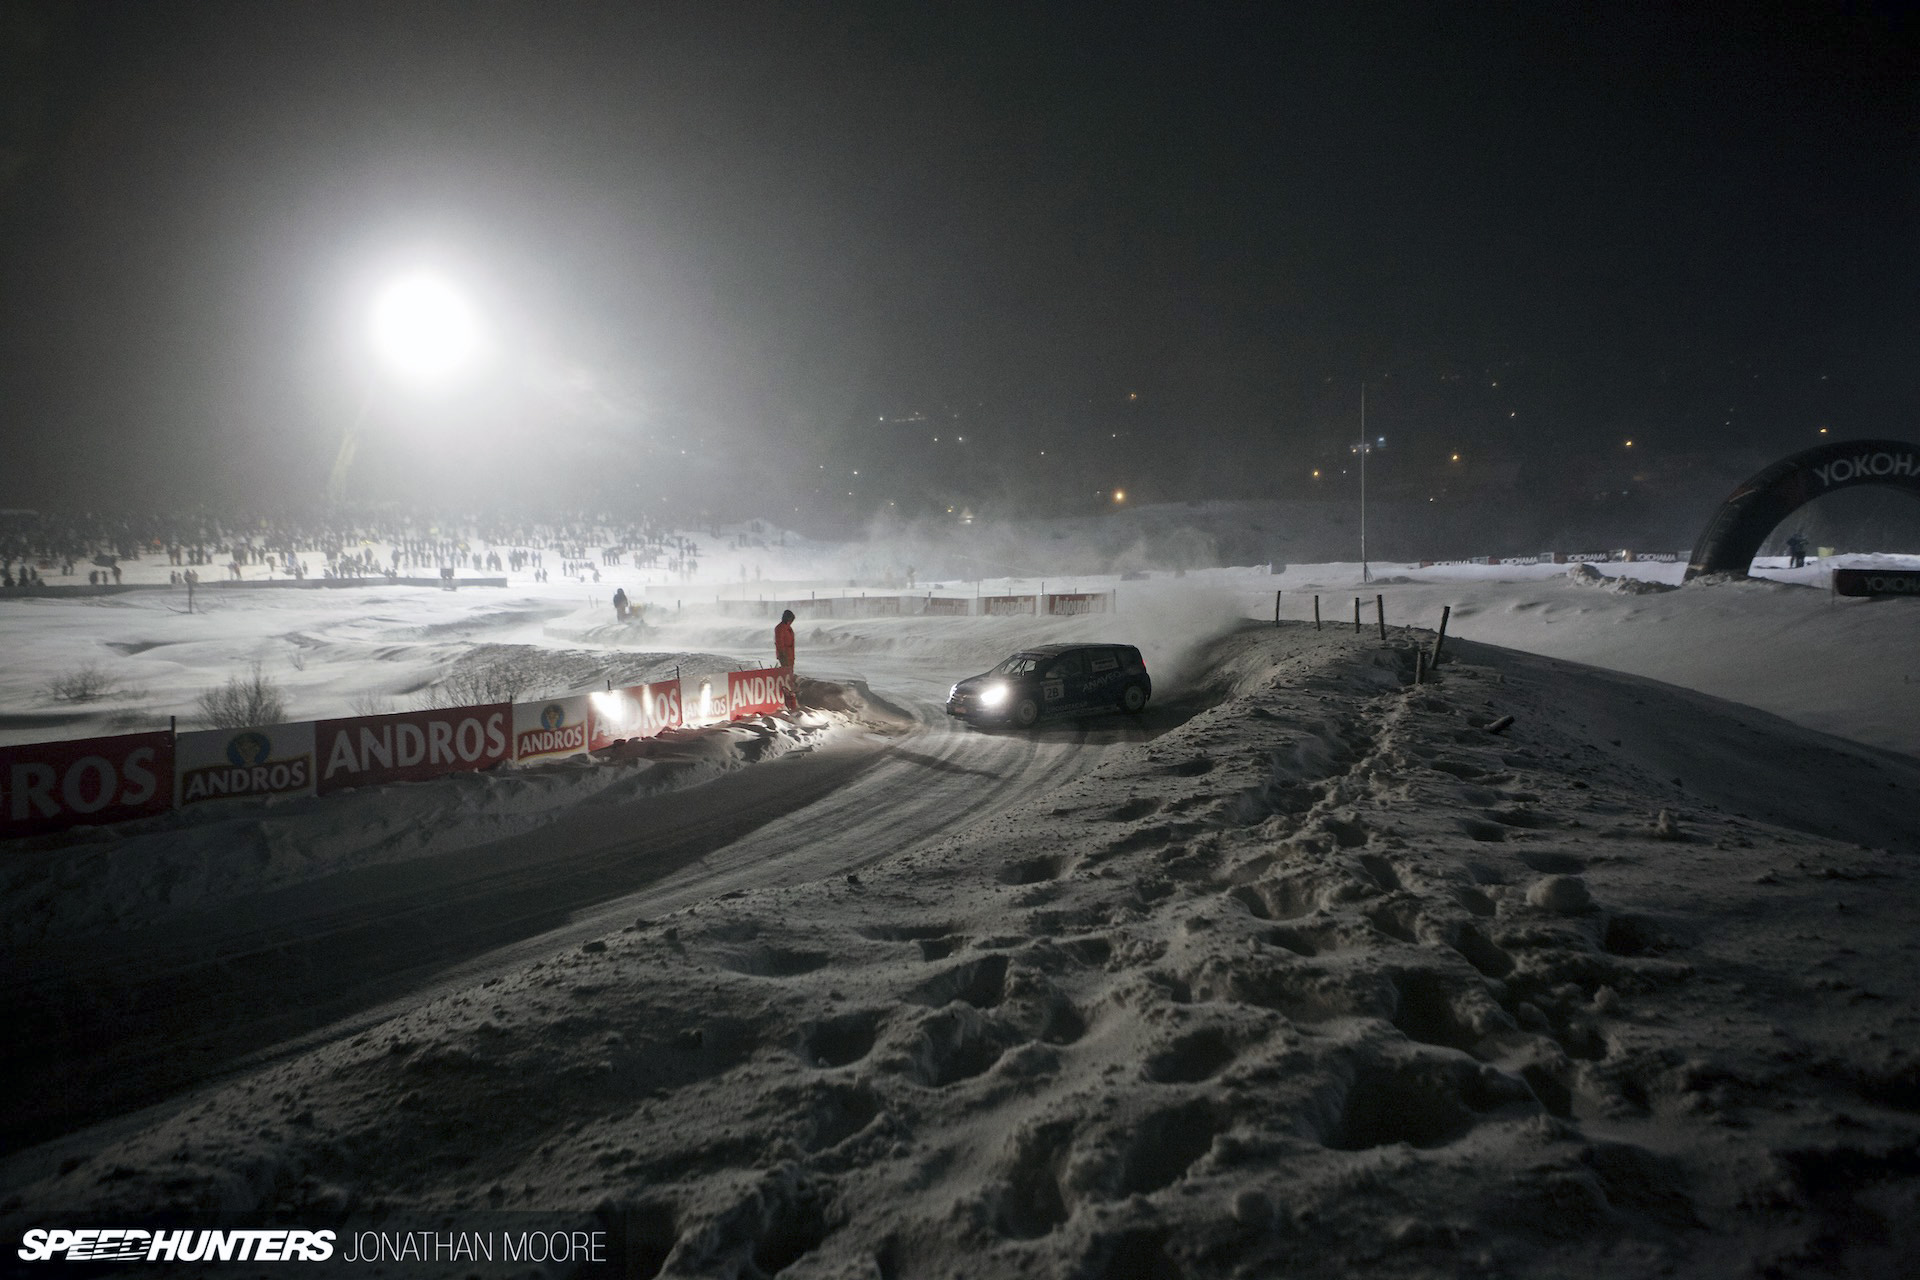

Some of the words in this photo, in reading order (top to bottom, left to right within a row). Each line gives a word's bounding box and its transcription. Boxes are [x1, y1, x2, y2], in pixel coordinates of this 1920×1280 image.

[685, 698, 726, 719] ANROS
[323, 712, 507, 781] ANDROS
[519, 727, 582, 756] ANDROS
[184, 761, 306, 800] ANDROS
